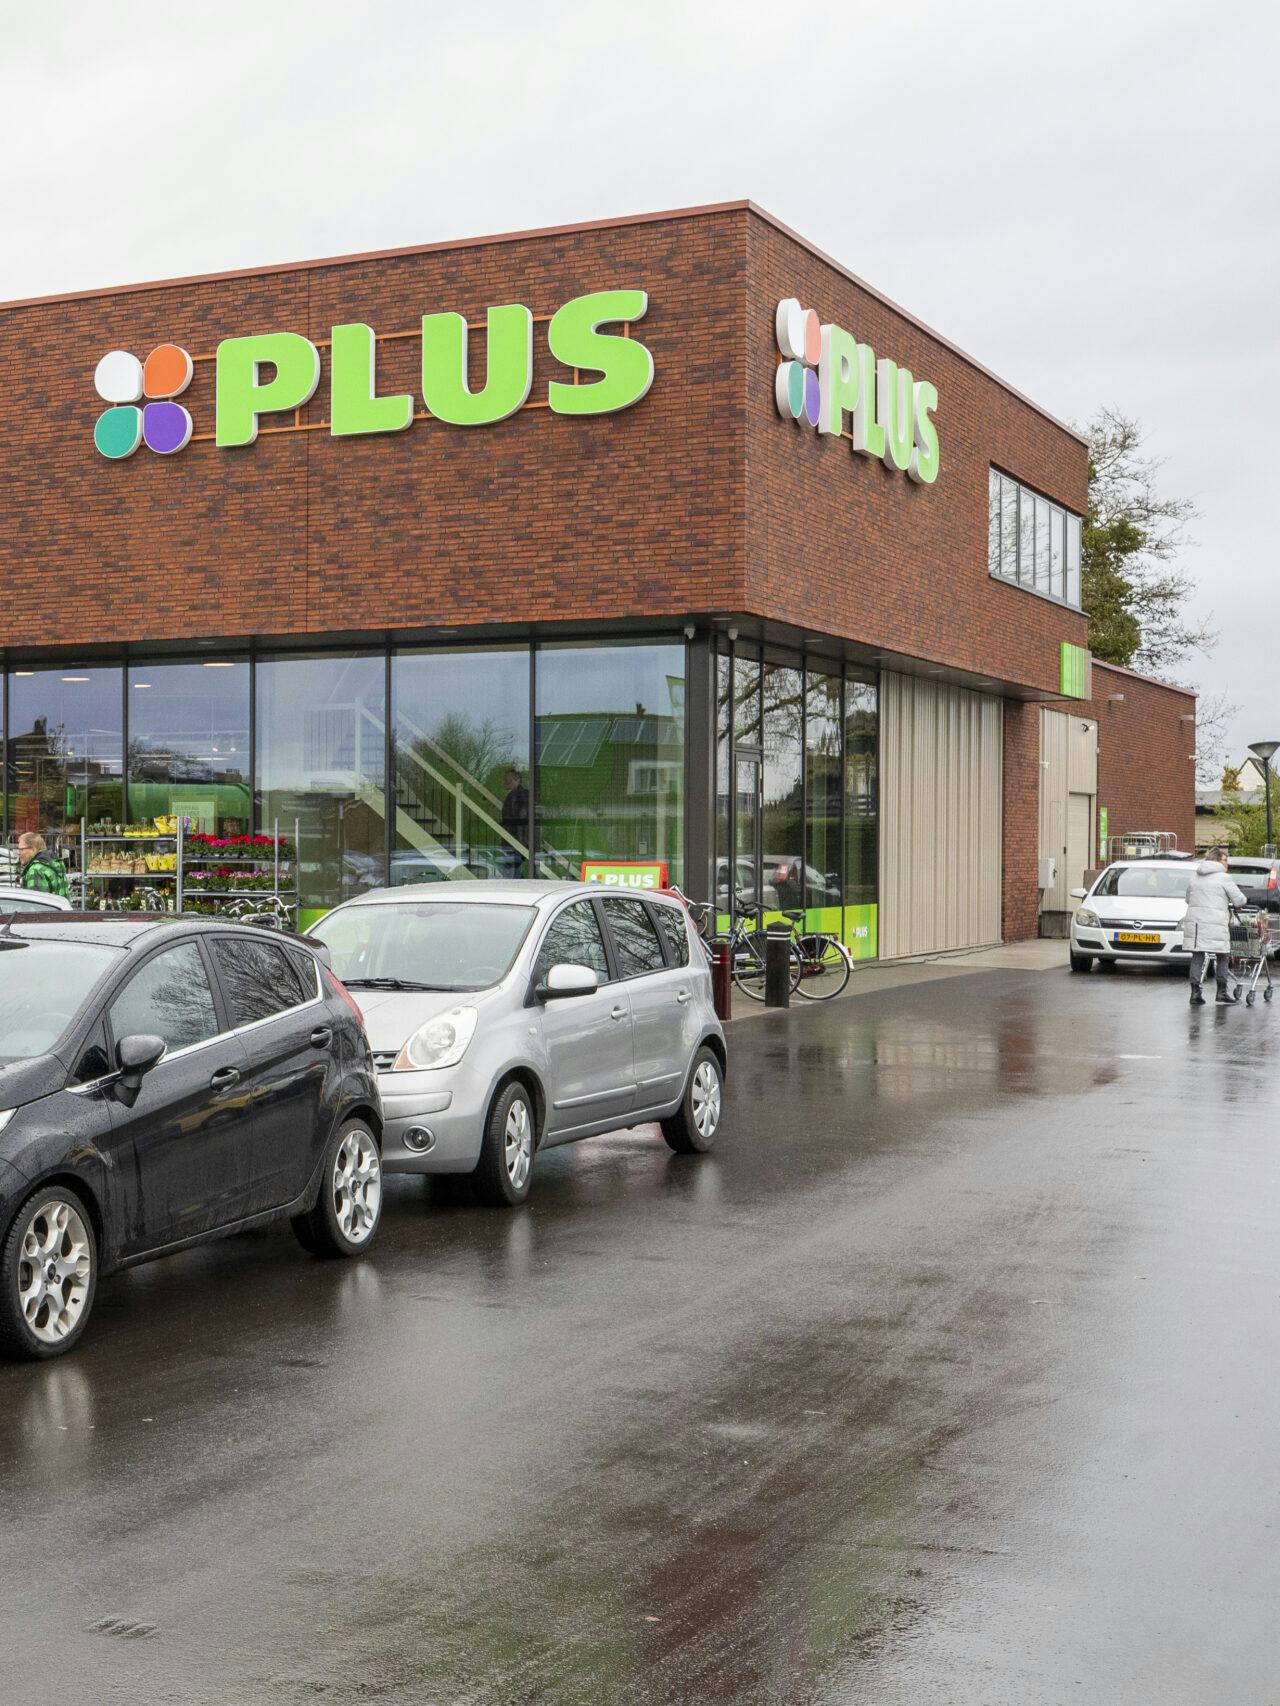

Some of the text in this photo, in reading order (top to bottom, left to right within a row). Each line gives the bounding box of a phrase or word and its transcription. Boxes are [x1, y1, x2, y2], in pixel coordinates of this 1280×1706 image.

[215, 289, 656, 448] PLUS
[817, 323, 940, 484] PLUS
[604, 873, 654, 887] PLUS
[1120, 933, 1157, 942] 07-PL-HK
